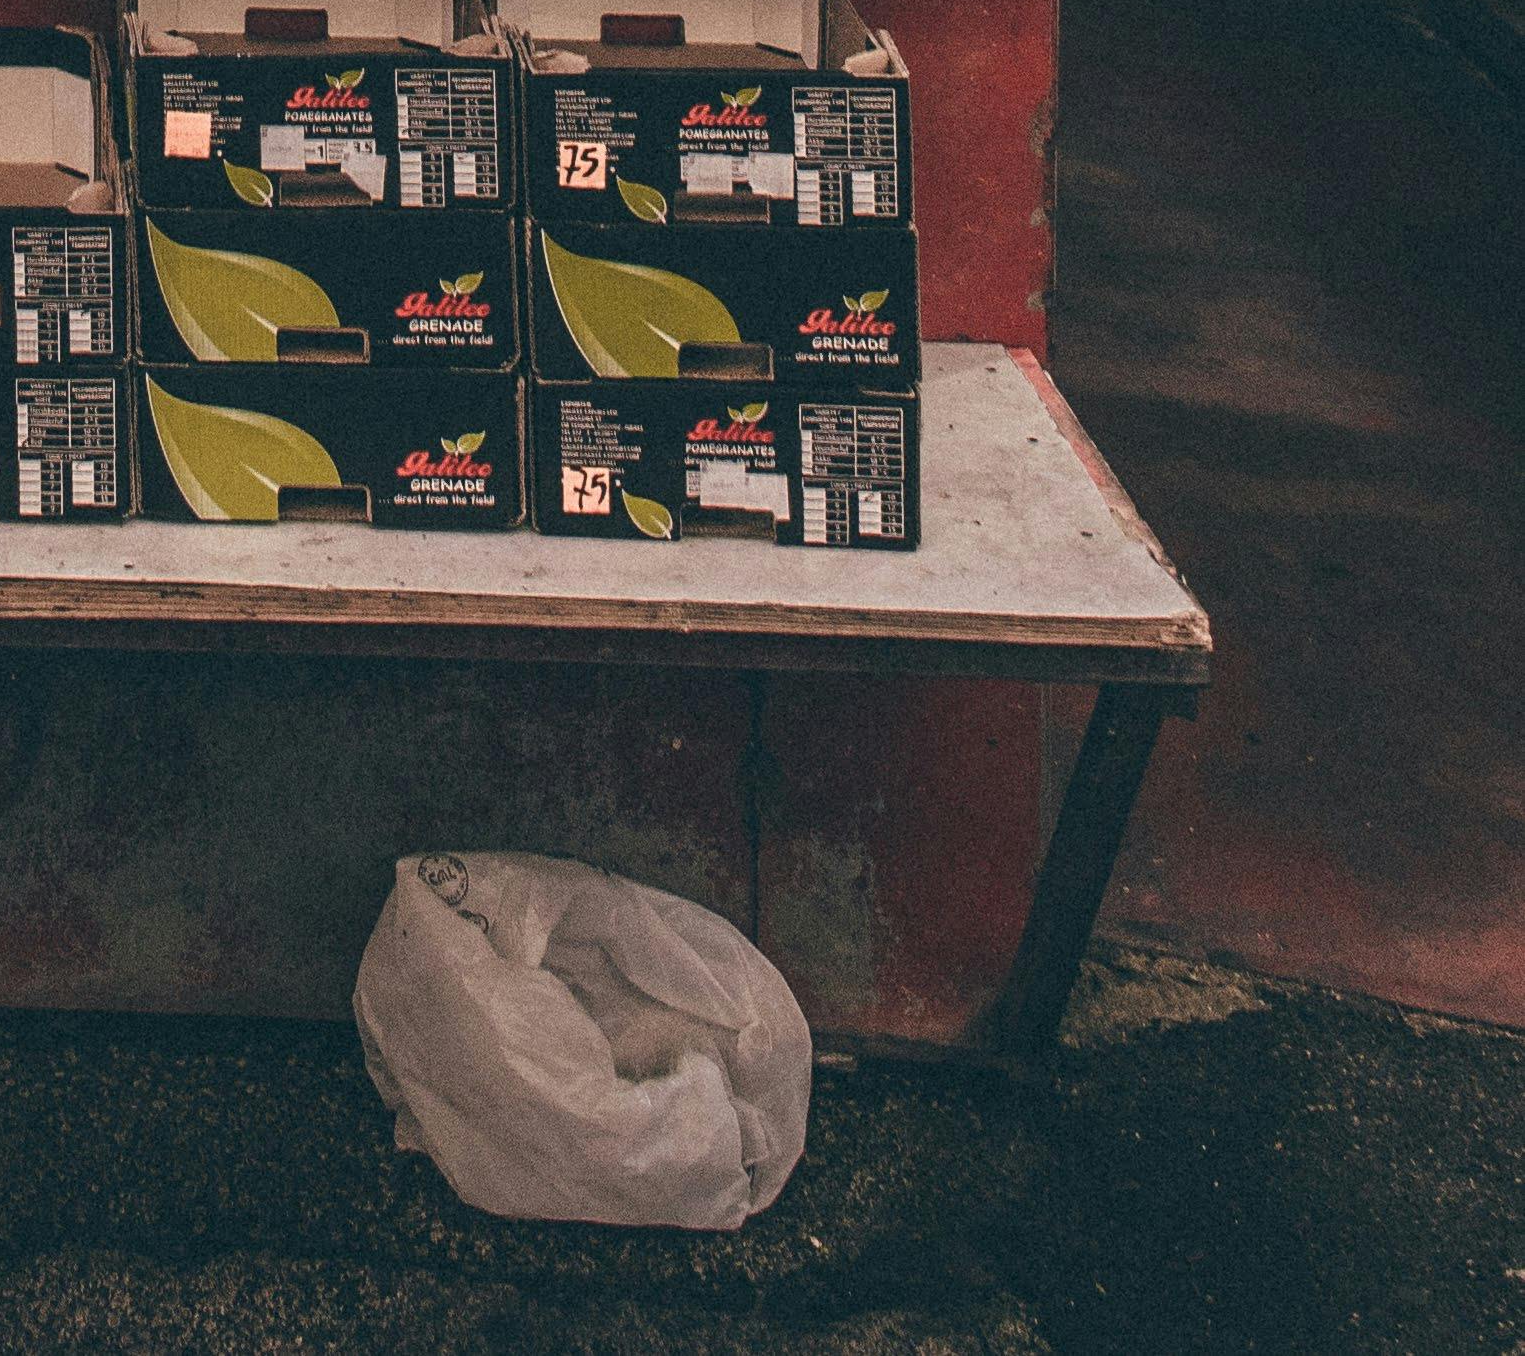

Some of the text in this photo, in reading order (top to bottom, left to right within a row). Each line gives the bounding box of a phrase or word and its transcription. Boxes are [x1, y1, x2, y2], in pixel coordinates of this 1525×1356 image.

[284, 111, 373, 123] POMEGRANATES
[679, 127, 770, 140] POMEGRANATES
[408, 319, 484, 333] GRENADE
[811, 336, 890, 352] GRENADE
[685, 442, 776, 456] POMEGRANATES
[410, 478, 485, 492] GRENADE
